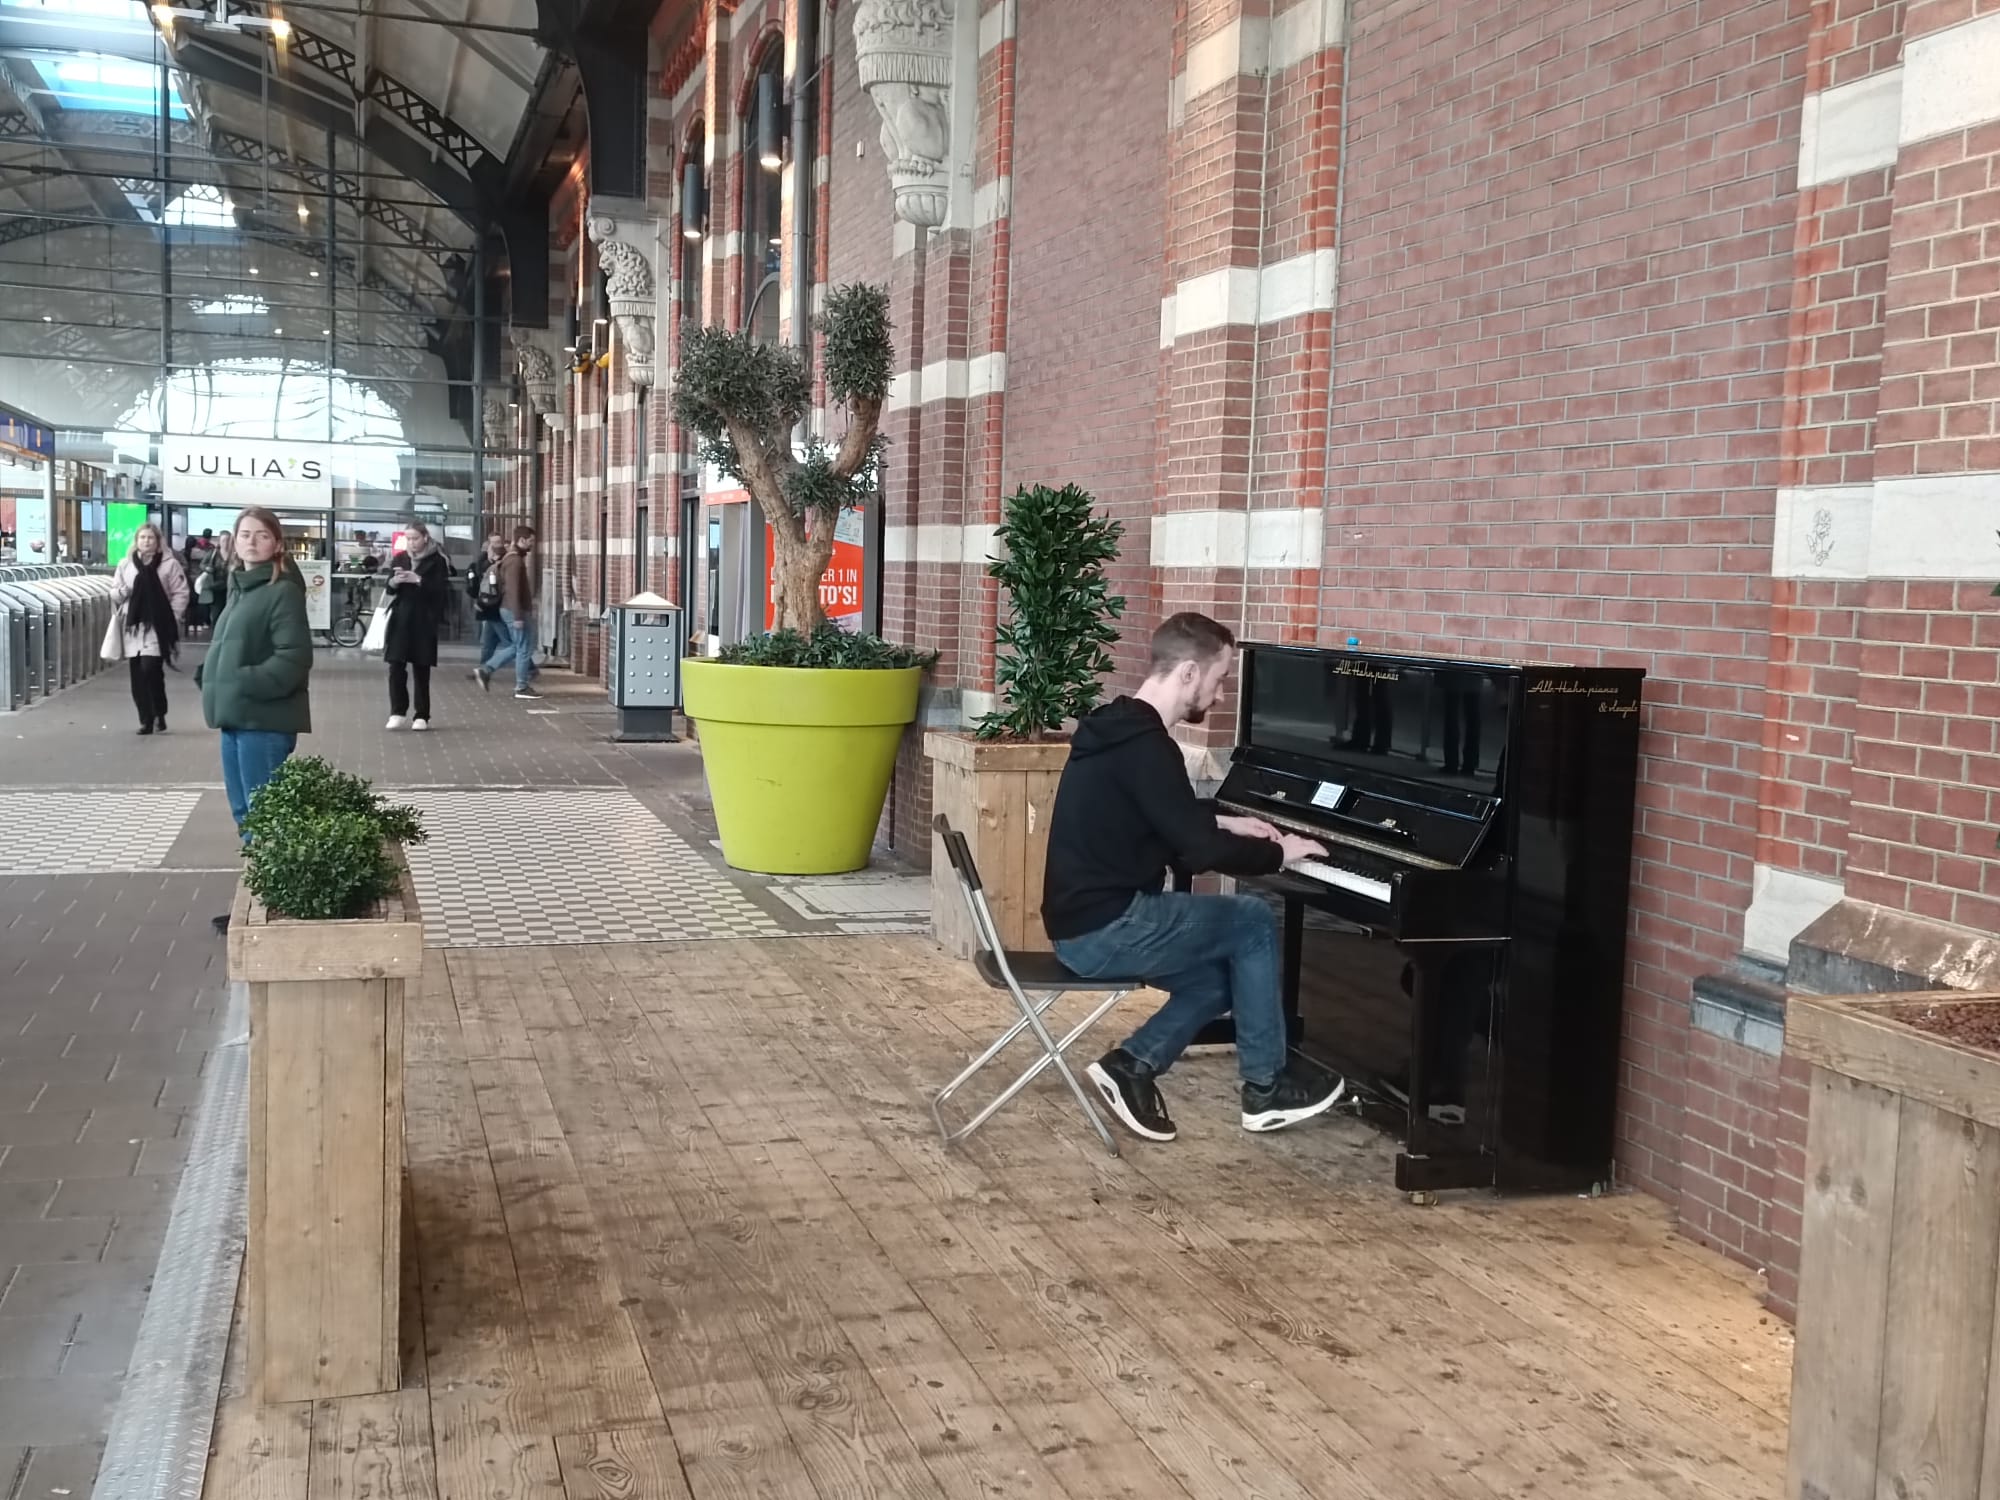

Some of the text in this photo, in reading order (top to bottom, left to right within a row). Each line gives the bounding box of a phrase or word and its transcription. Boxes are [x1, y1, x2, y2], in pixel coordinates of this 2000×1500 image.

[174, 455, 321, 479] JULIA'S
[838, 568, 843, 582] 1
[846, 569, 857, 582] IN
[1587, 687, 1618, 697] pianos
[1599, 702, 1607, 712] &
